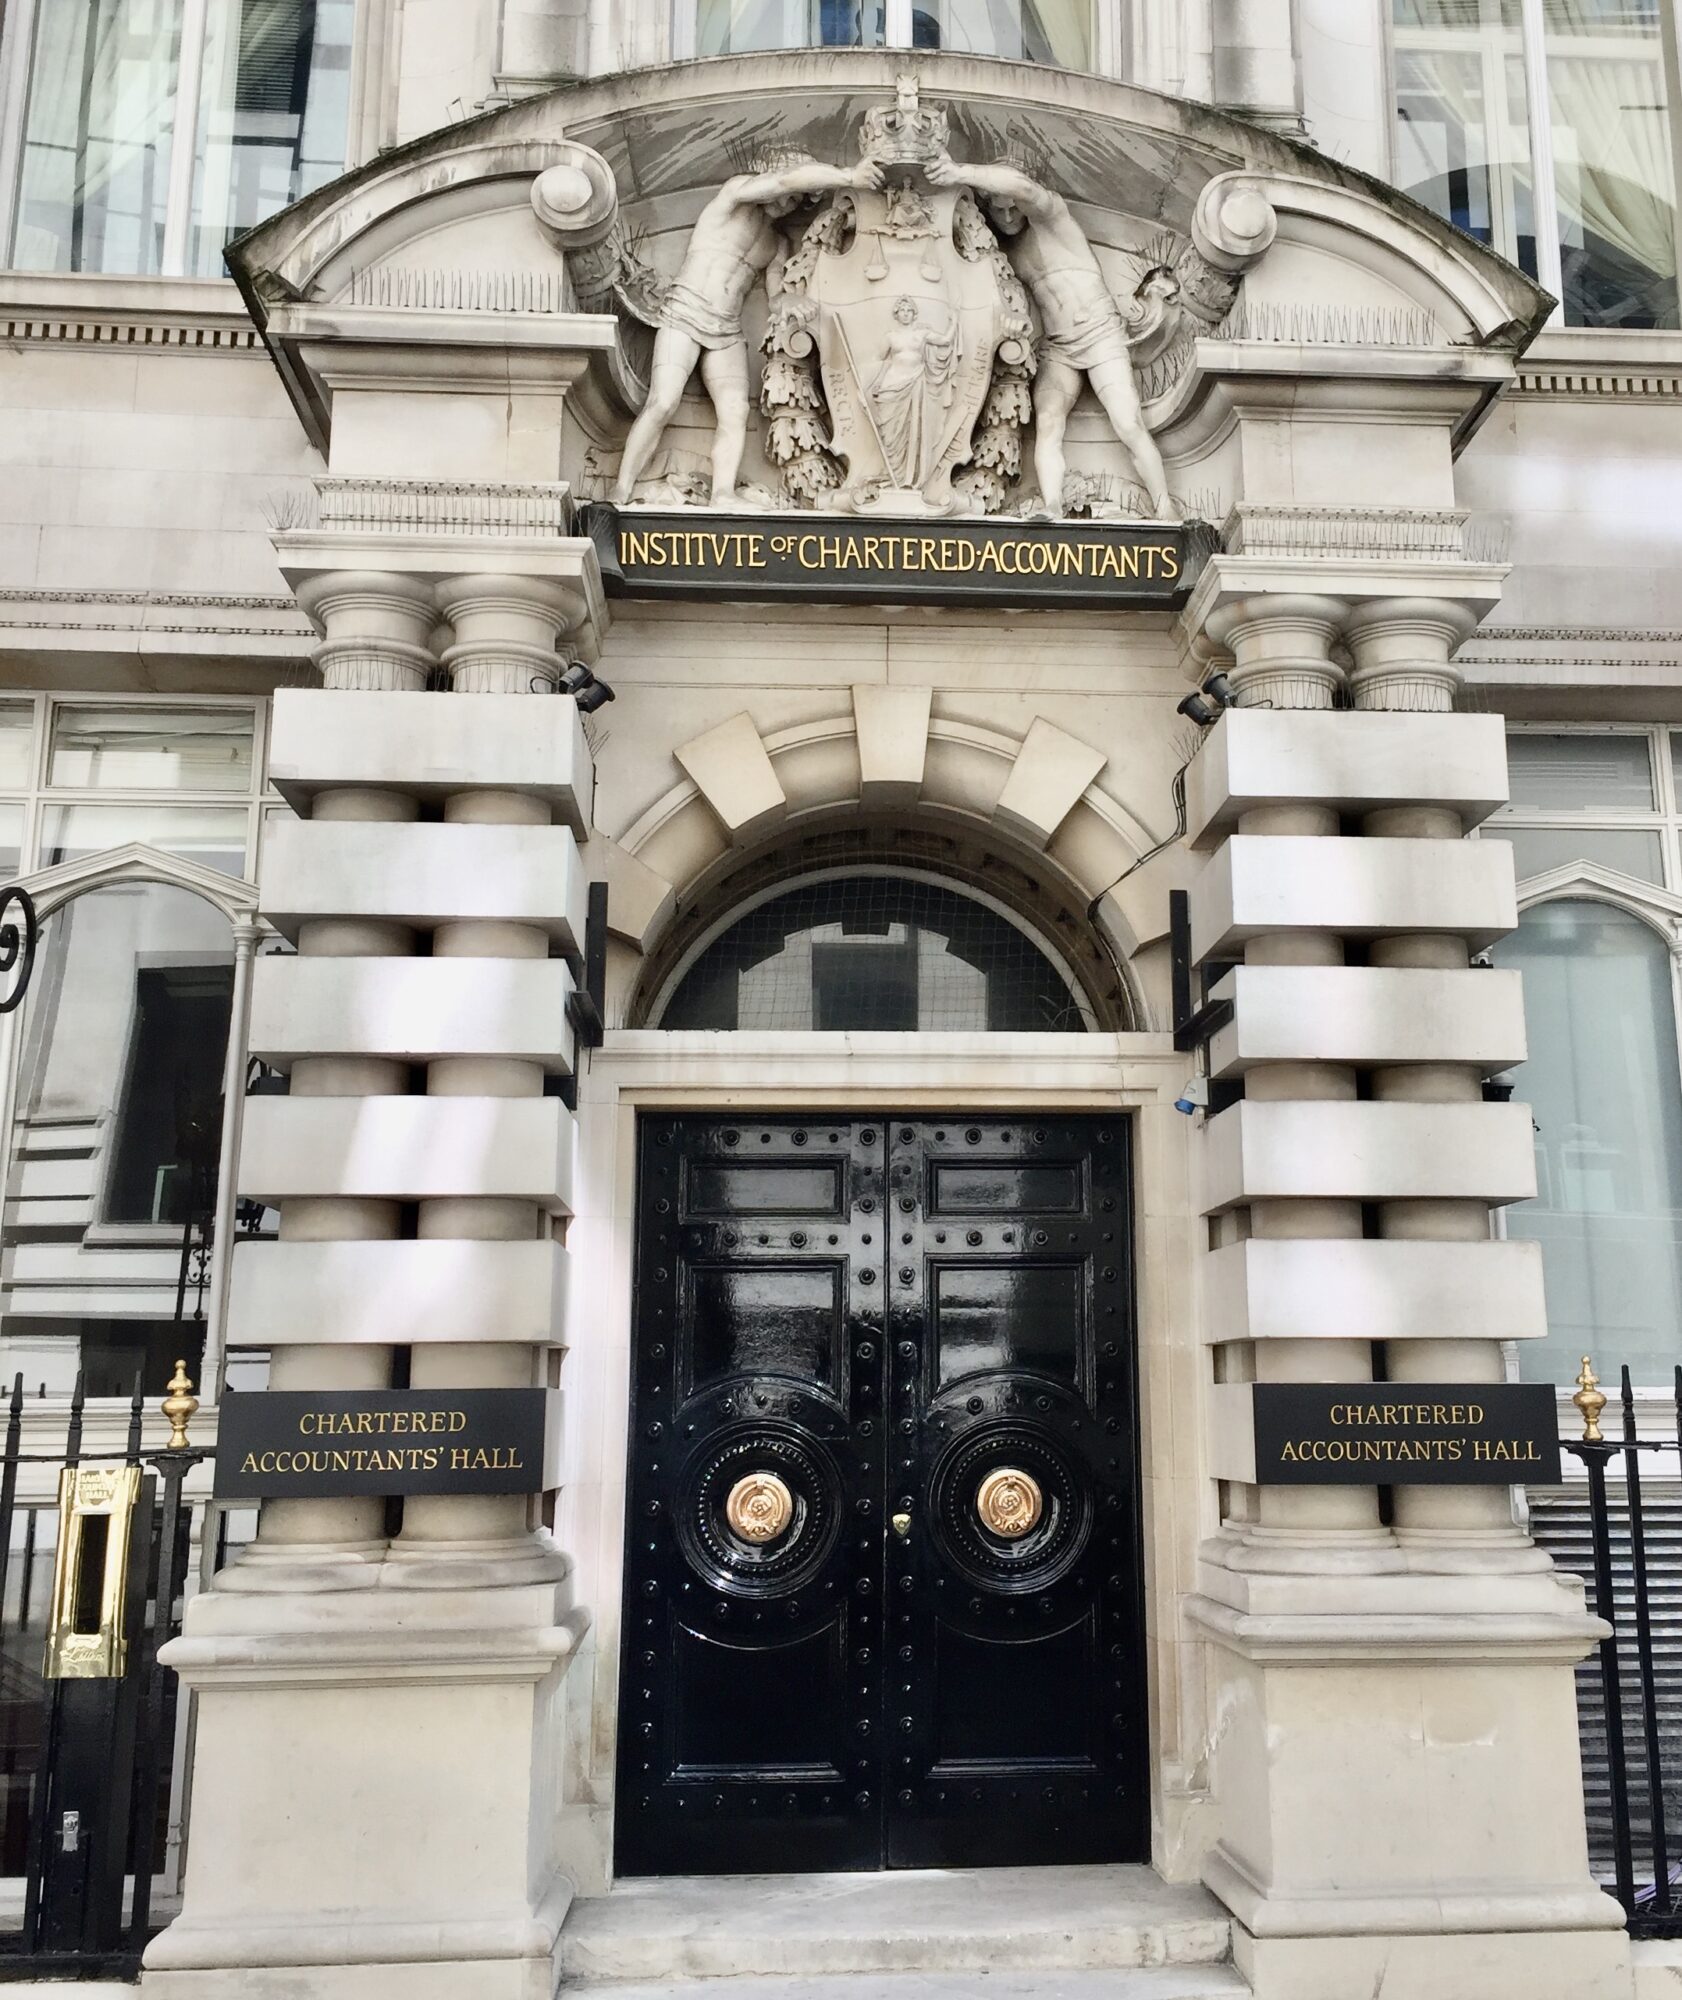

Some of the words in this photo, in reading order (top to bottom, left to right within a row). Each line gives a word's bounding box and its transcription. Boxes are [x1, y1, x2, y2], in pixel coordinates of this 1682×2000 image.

[798, 535, 975, 572] CHARTERED
[299, 1411, 467, 1434] CHARTERED
[1330, 1404, 1484, 1425] CHARTERED
[239, 1446, 445, 1473] ACCOUNTANTS'
[450, 1447, 523, 1469] HALL
[1280, 1439, 1467, 1461] ACCOUNTANTS'
[1473, 1440, 1542, 1461] HALL
